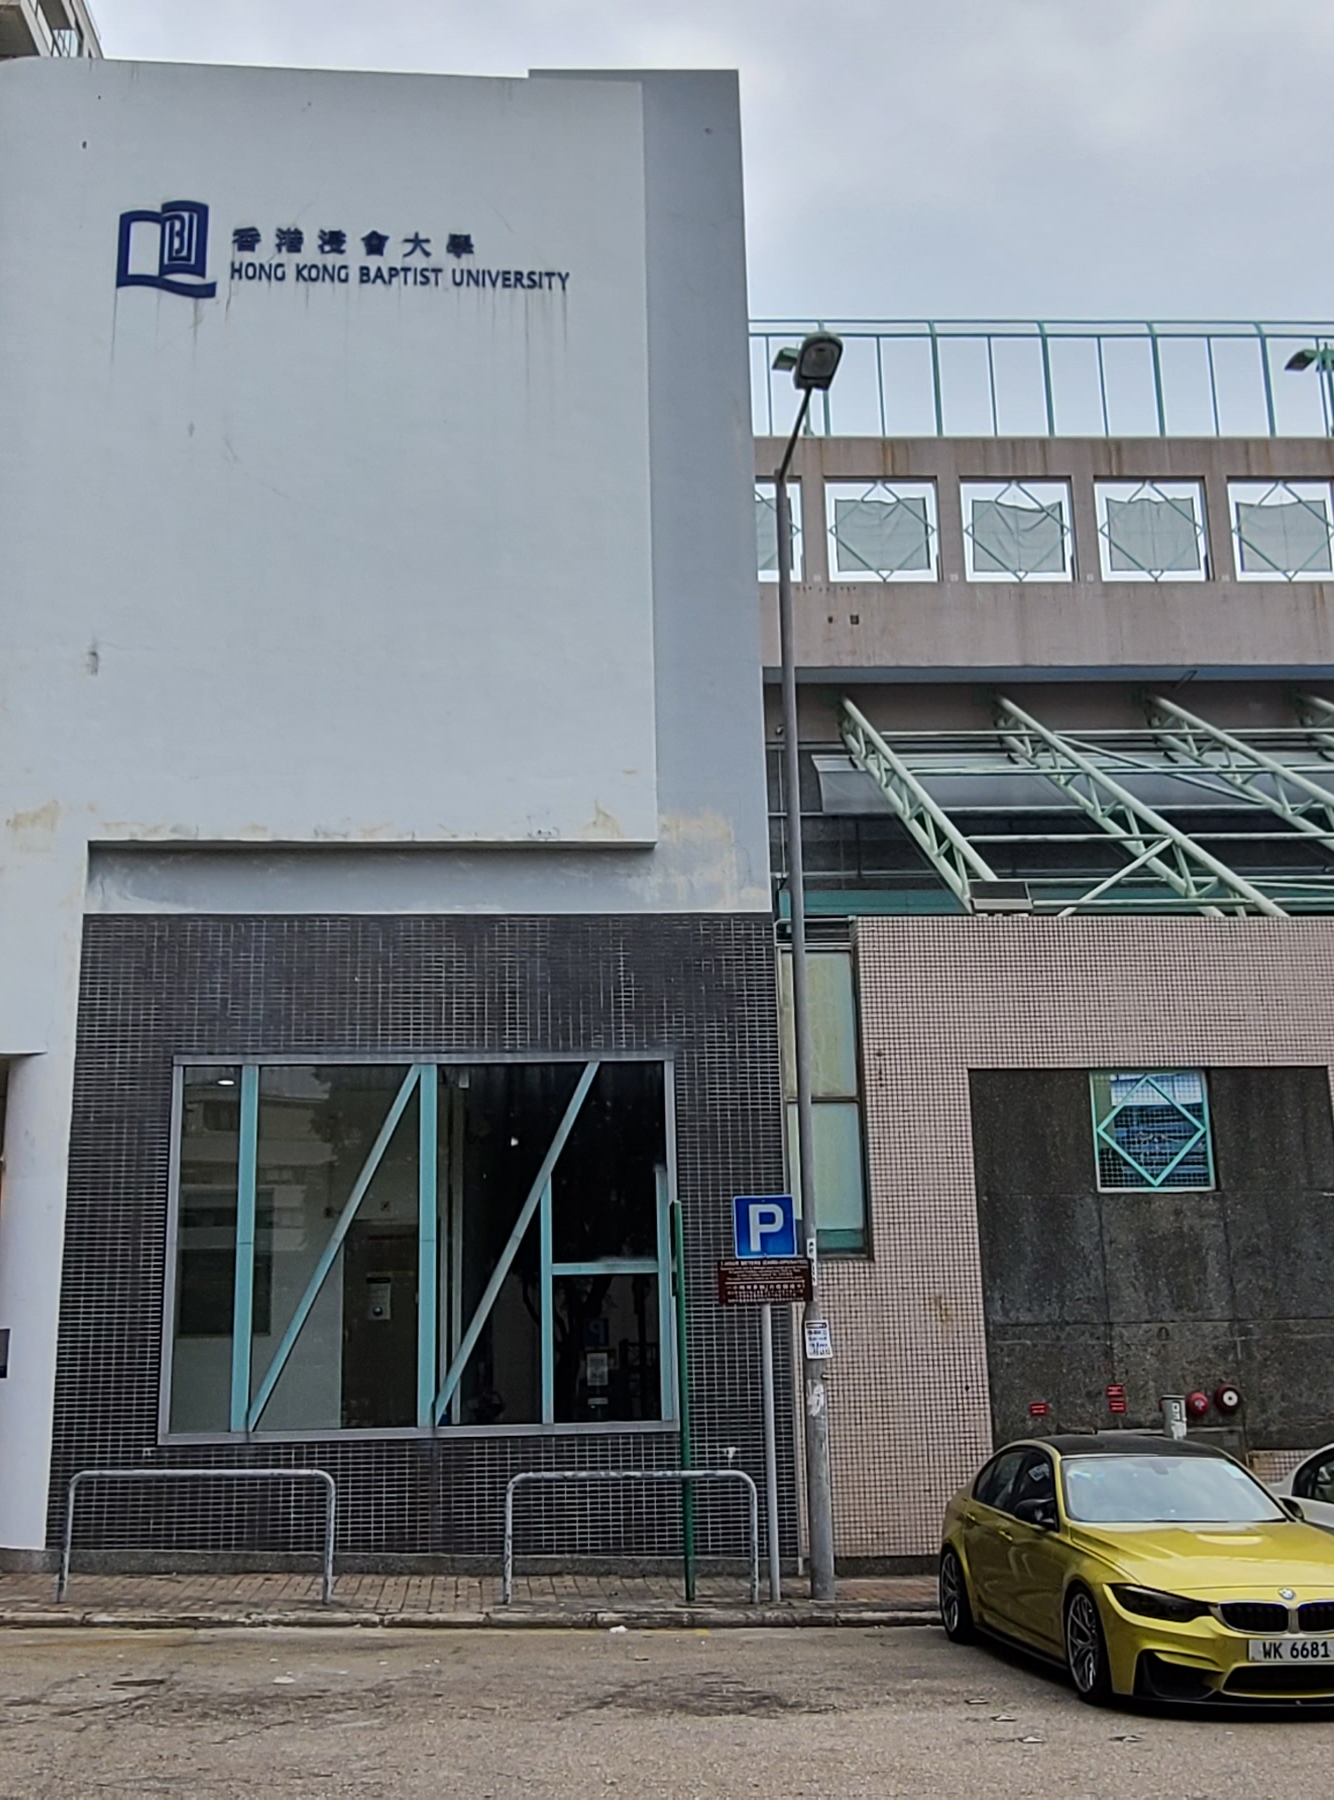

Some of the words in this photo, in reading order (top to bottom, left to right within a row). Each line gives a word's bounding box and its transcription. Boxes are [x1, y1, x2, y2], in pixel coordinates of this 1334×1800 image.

[232, 226, 475, 259] 香港浸會大學
[230, 261, 286, 282] HONG
[295, 263, 349, 284] KONG
[358, 265, 443, 287] BAPTIST
[451, 267, 571, 292] UNIVERSITY
[748, 1203, 784, 1252] P
[1262, 1641, 1283, 1660] WK
[1289, 1640, 1330, 1659] 6681
